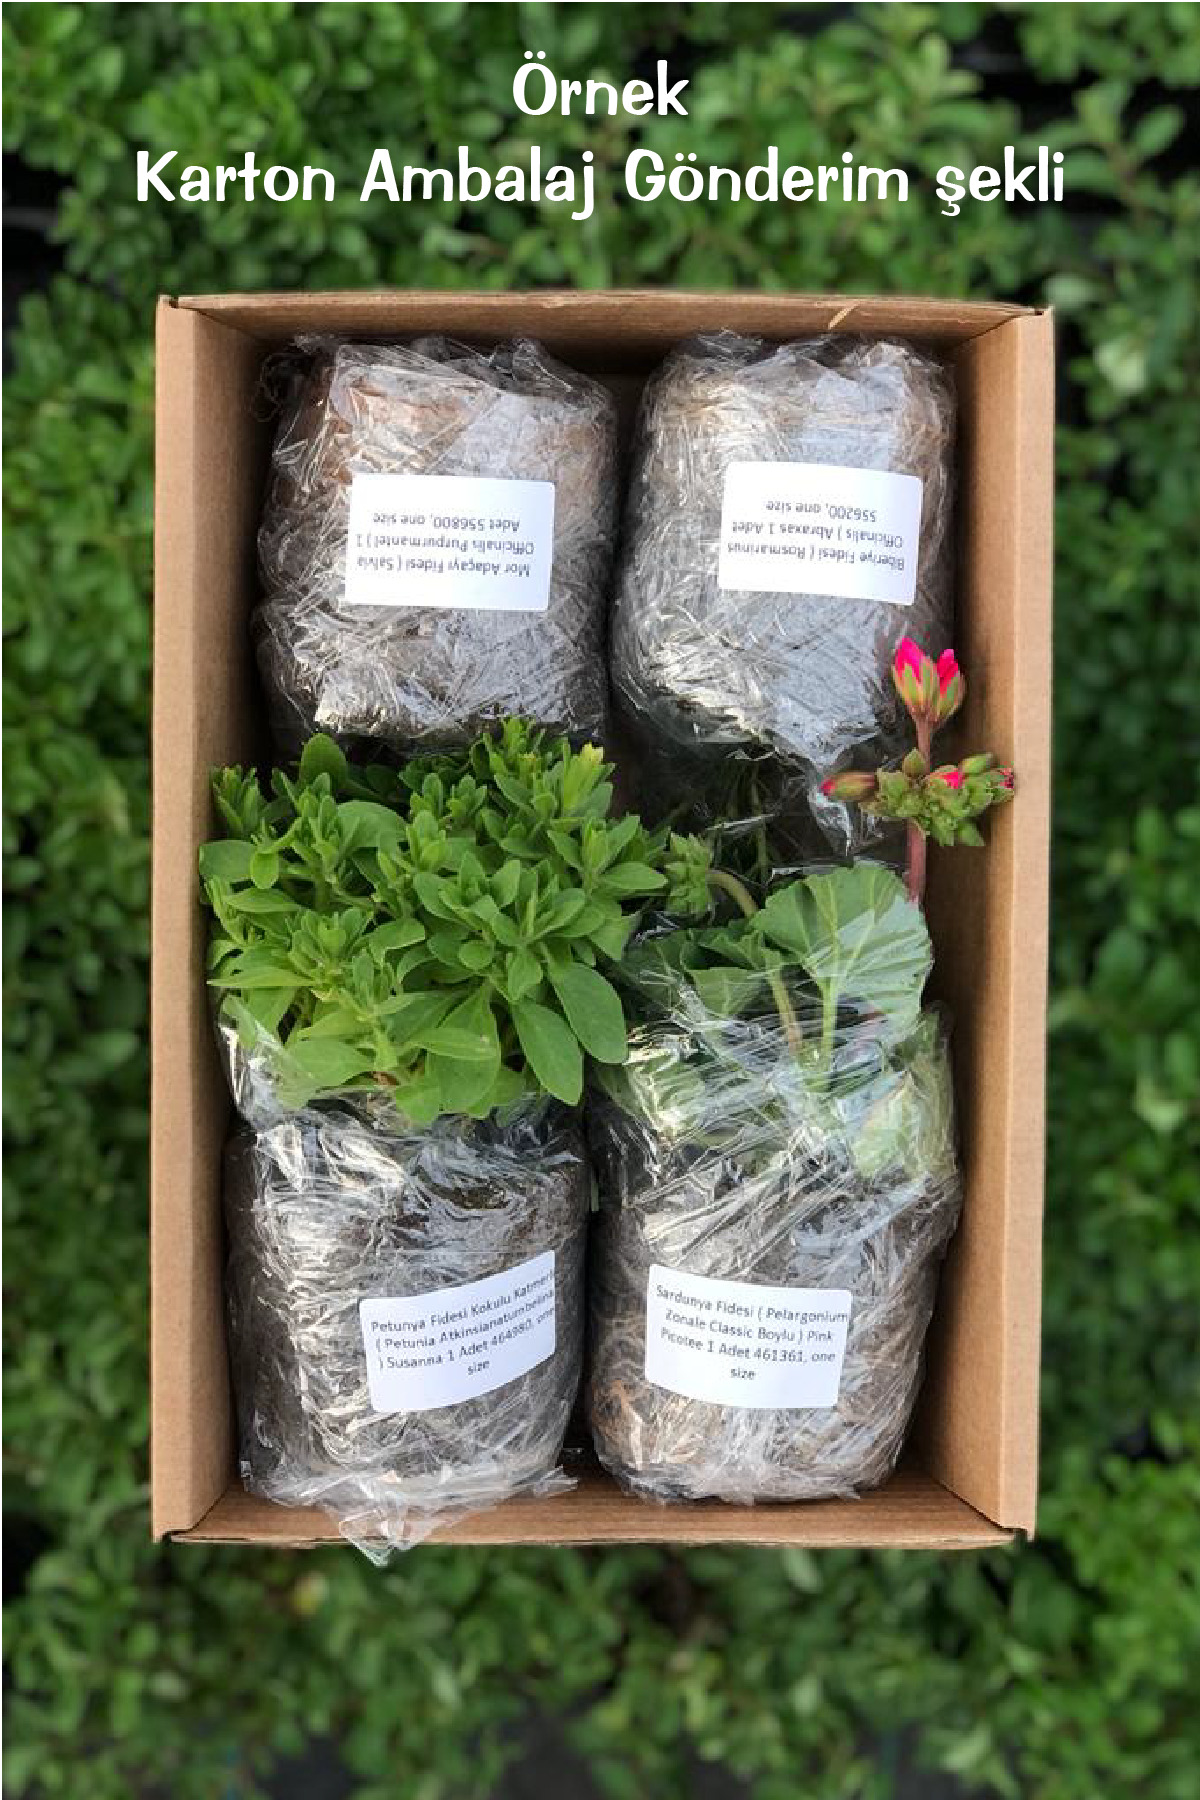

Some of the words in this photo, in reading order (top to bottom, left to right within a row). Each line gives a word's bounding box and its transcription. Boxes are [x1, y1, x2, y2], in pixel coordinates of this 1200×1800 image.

[766, 501, 791, 512] size
[796, 503, 821, 513] one
[373, 513, 397, 524] size
[401, 514, 425, 524] one
[489, 519, 520, 532] Adet
[732, 521, 763, 534] Adet
[780, 524, 834, 539] Abraxas
[846, 529, 902, 548] Officinalis
[472, 540, 534, 555] Officinalis
[728, 543, 805, 559] Rosmarinus
[819, 548, 855, 563] Fidesi
[859, 552, 904, 570] Biberiye
[357, 557, 393, 571] Salvia
[406, 558, 443, 573] Fidesi
[504, 563, 530, 577] Mor
[657, 1285, 712, 1310] Sardunya
[717, 1301, 753, 1318] Fidesi
[766, 1308, 848, 1324] Pelargonium
[371, 1320, 426, 1332] Petunya
[431, 1310, 468, 1325] Fidesi
[471, 1296, 511, 1317] Kokulu
[666, 1308, 706, 1330] Zonale
[710, 1319, 752, 1338] Classic
[758, 1327, 795, 1342] Boylu
[807, 1331, 832, 1341] Pink
[385, 1336, 435, 1348] Petunia
[387, 1355, 442, 1368] Susanna
[460, 1341, 489, 1358] Adet
[719, 1343, 750, 1359] Adet
[812, 1353, 836, 1362] one
[468, 1361, 489, 1375] size
[731, 1368, 755, 1380] size
